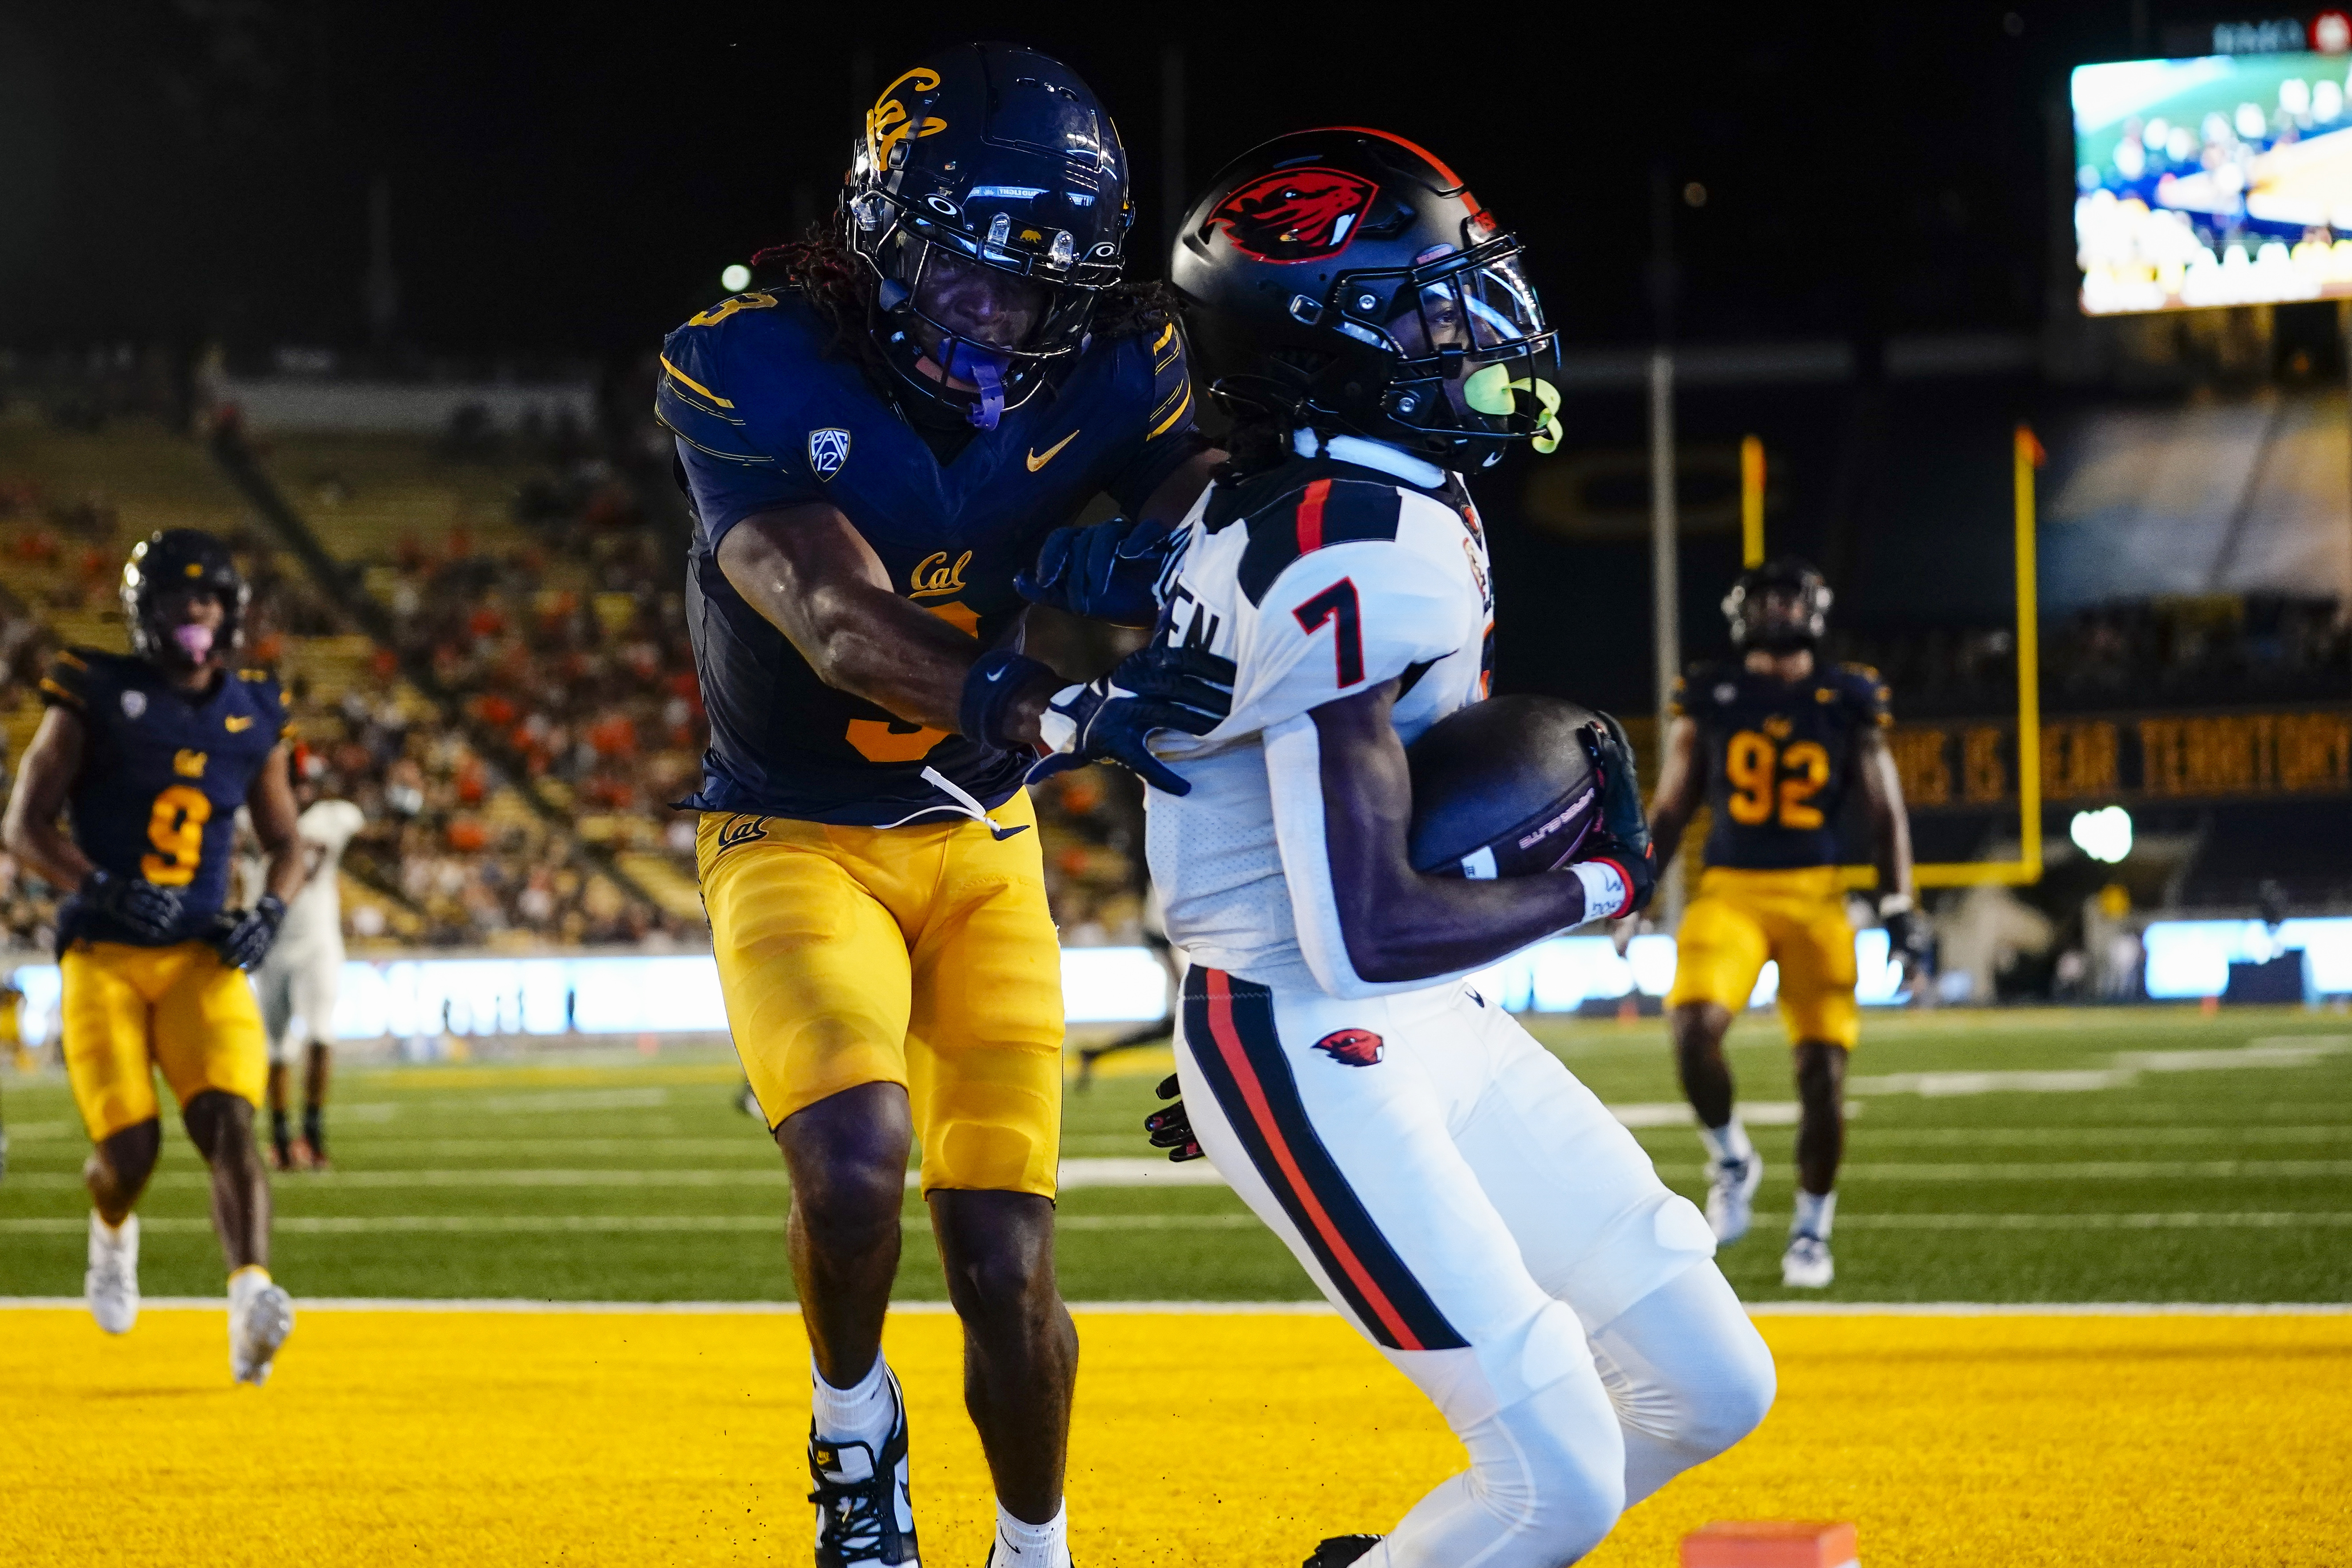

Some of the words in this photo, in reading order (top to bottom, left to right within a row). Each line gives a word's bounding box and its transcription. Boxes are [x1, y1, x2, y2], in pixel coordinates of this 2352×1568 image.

[866, 68, 947, 171] Cal
[811, 430, 848, 461] PAC
[817, 452, 838, 471] 12
[908, 550, 972, 599] Cal
[1293, 576, 1365, 688] 7
[1726, 730, 1830, 829] 92
[141, 786, 211, 885] 9
[717, 813, 776, 857] Cal
